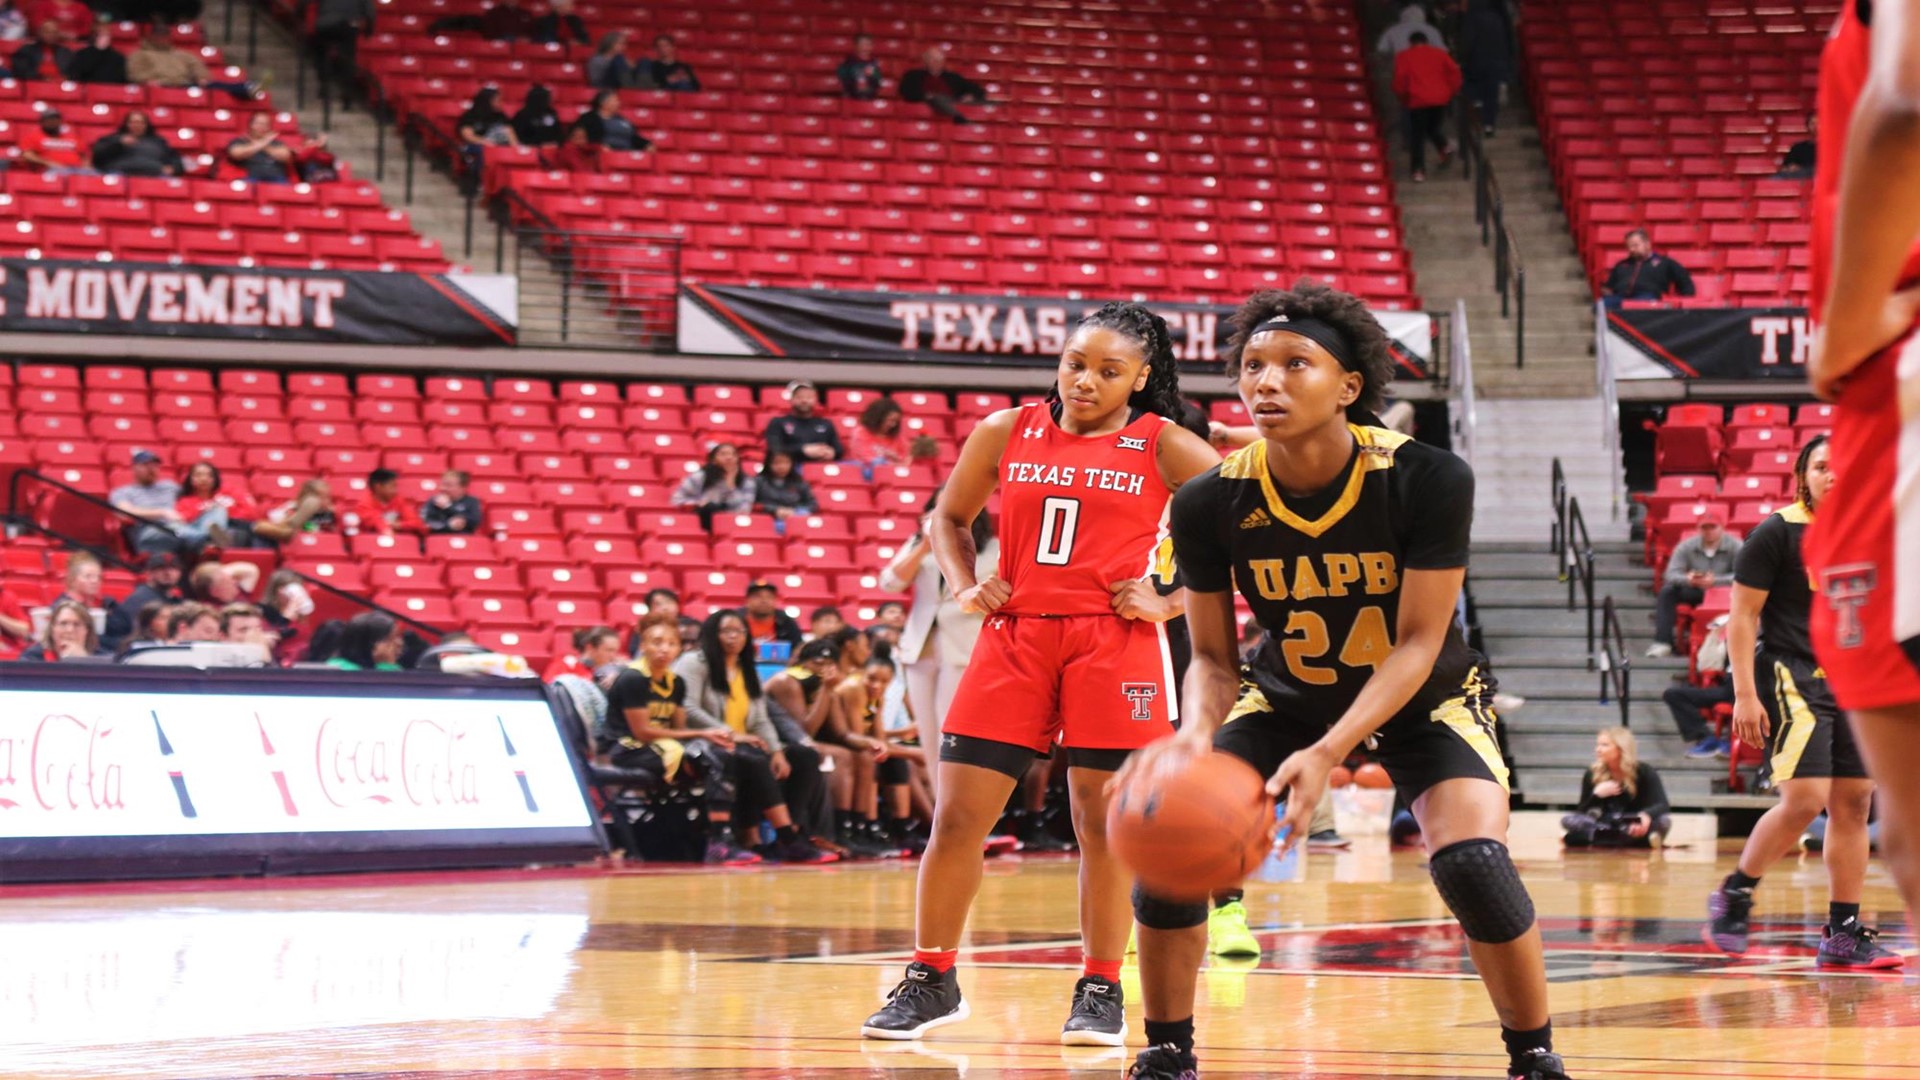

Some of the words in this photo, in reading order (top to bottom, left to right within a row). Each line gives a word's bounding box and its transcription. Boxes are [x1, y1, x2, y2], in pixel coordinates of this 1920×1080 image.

[27, 267, 345, 328] MOVEMENT
[891, 301, 1066, 355] TEXAS
[1007, 462, 1076, 487] TEXAS
[1084, 468, 1145, 496] TECH
[1036, 496, 1080, 566] 0
[1248, 552, 1398, 600] UAPB
[1281, 606, 1395, 685] 24
